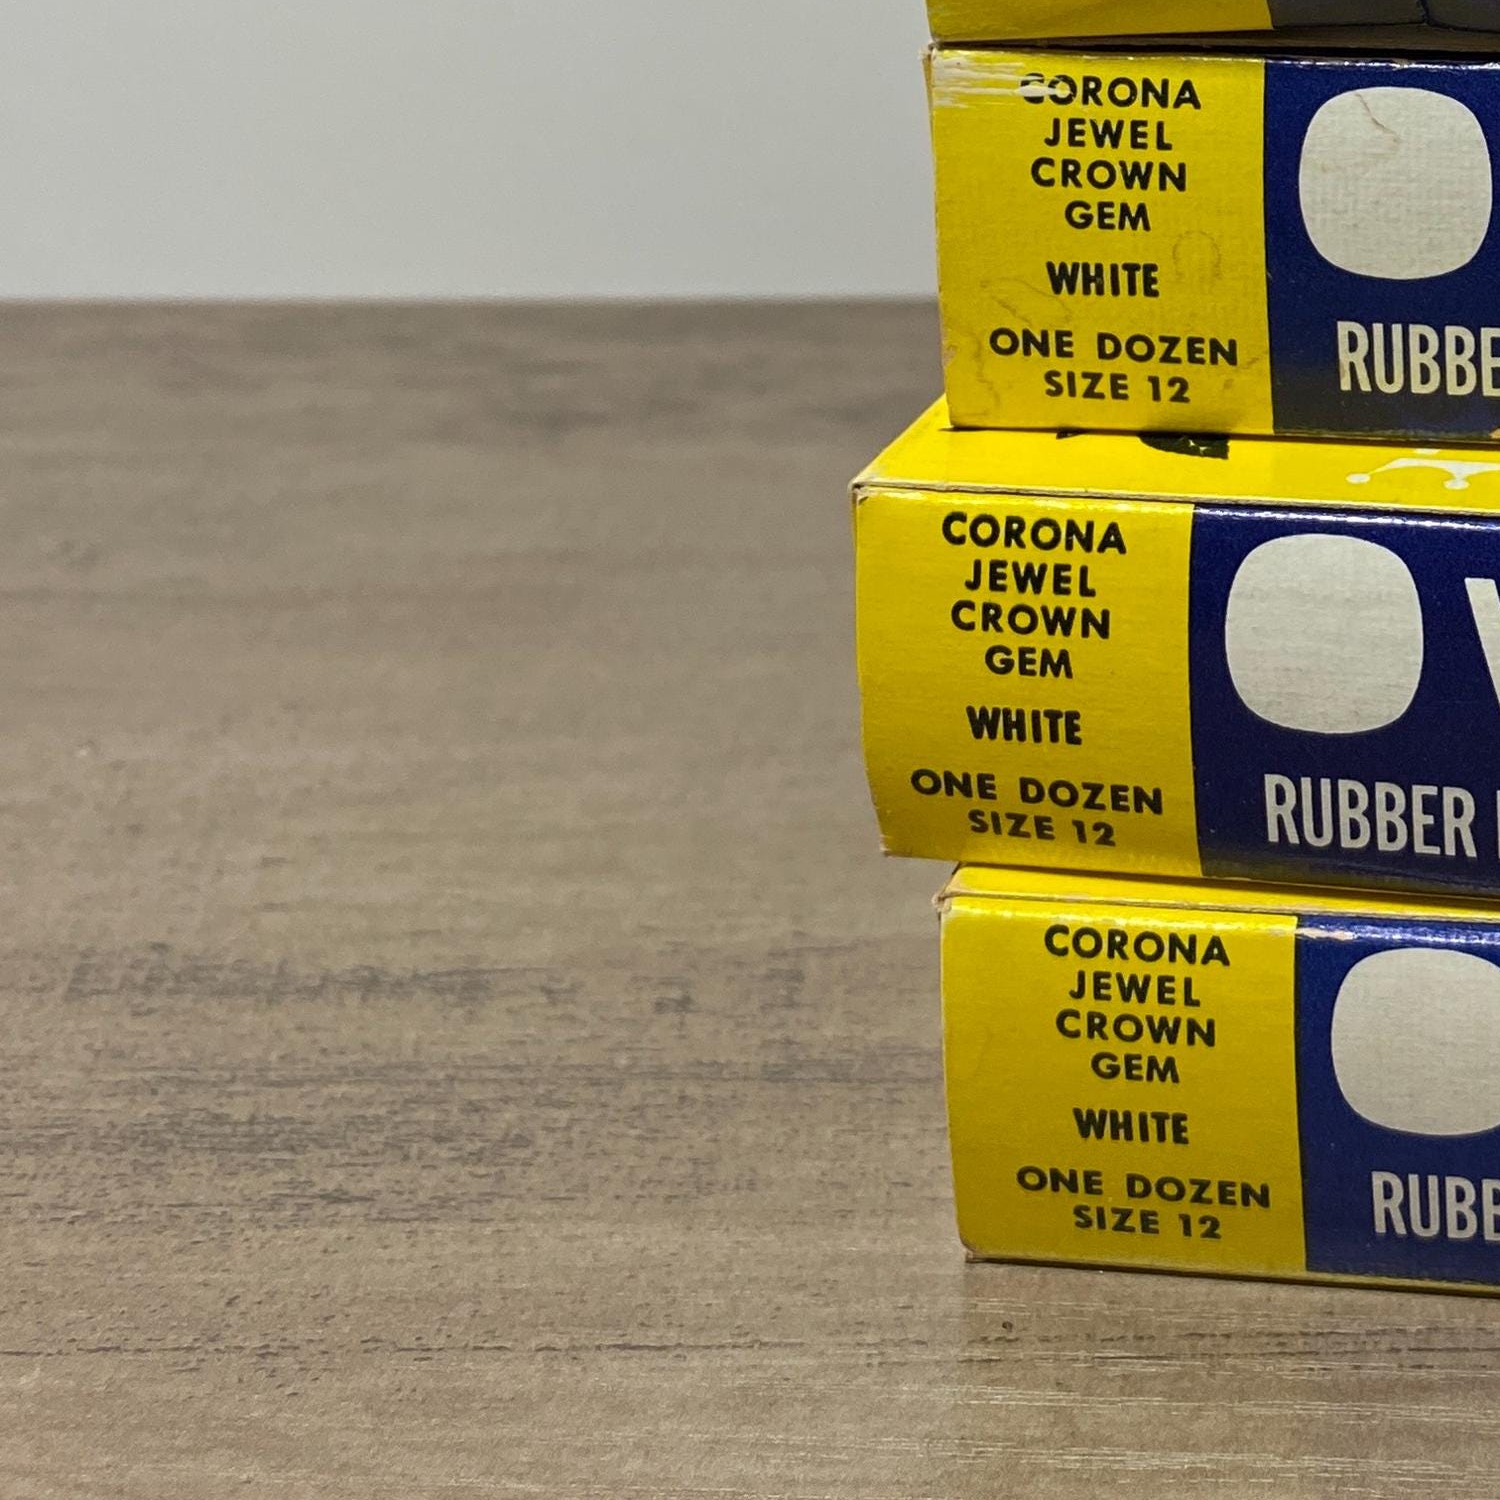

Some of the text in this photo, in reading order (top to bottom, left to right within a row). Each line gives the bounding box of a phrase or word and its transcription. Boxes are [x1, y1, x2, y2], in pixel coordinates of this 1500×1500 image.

[1020, 73, 1201, 110] CORONA
[1044, 118, 1173, 151] JEWEL
[1030, 158, 1187, 192] CROWN
[1064, 200, 1151, 232] GEM
[1046, 261, 1159, 298] WHITE
[989, 327, 1238, 366] ONE DOZEN
[1044, 370, 1190, 404] SIZE 12
[941, 512, 1126, 555] CORONA
[965, 560, 1097, 597] JEWEL
[951, 600, 1111, 639] CROWN
[984, 646, 1073, 679] GEM
[966, 706, 1082, 745] WHITE
[910, 768, 1163, 816] ONE DOZEN
[968, 810, 1116, 847] SIZE 12
[1263, 773, 1477, 860] RUBBER
[1044, 925, 1231, 967] CORONA
[1069, 970, 1201, 1008] JEWEL
[1055, 1009, 1216, 1048] CROWN
[1091, 1053, 1180, 1084] GEM
[1073, 1108, 1190, 1145] WHITE
[1016, 1165, 1271, 1209] ONE DOZEN
[1073, 1205, 1222, 1240] SIZE 12
